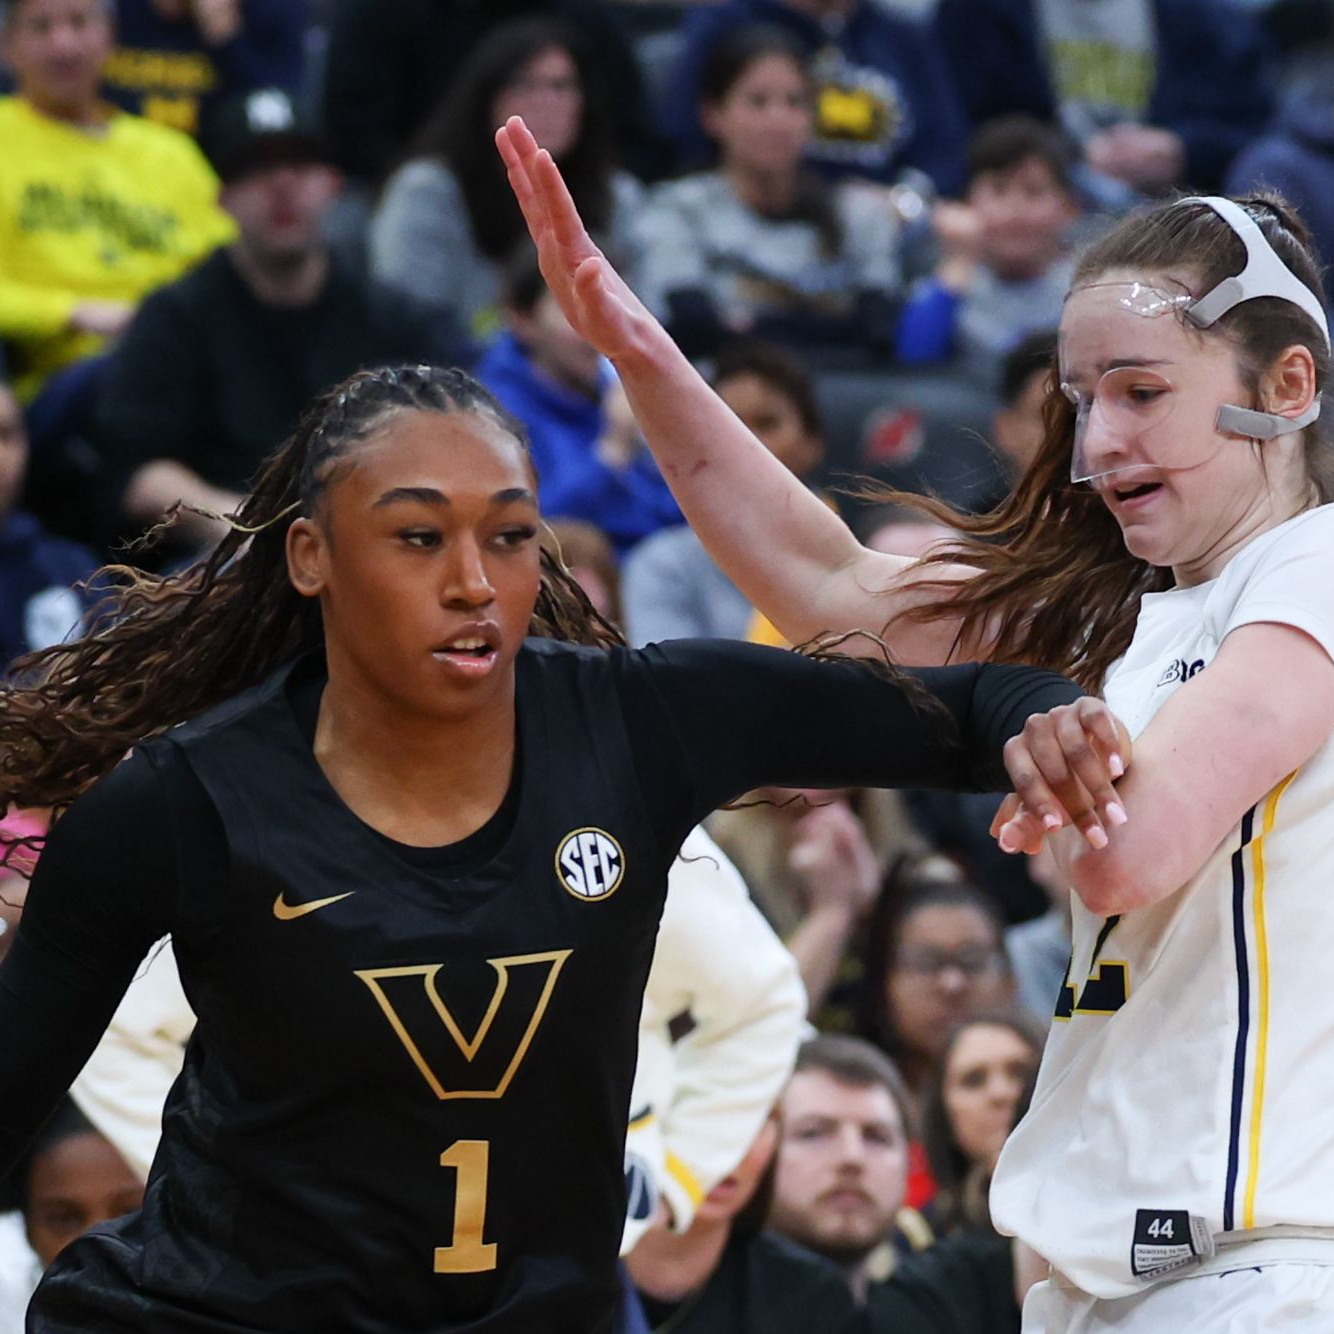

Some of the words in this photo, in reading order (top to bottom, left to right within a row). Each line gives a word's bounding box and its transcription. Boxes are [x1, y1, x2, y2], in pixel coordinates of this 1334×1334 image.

[560, 832, 621, 897] SEC
[353, 949, 574, 1100] V
[433, 1139, 498, 1273] 1
[1147, 1218, 1175, 1239] 44
